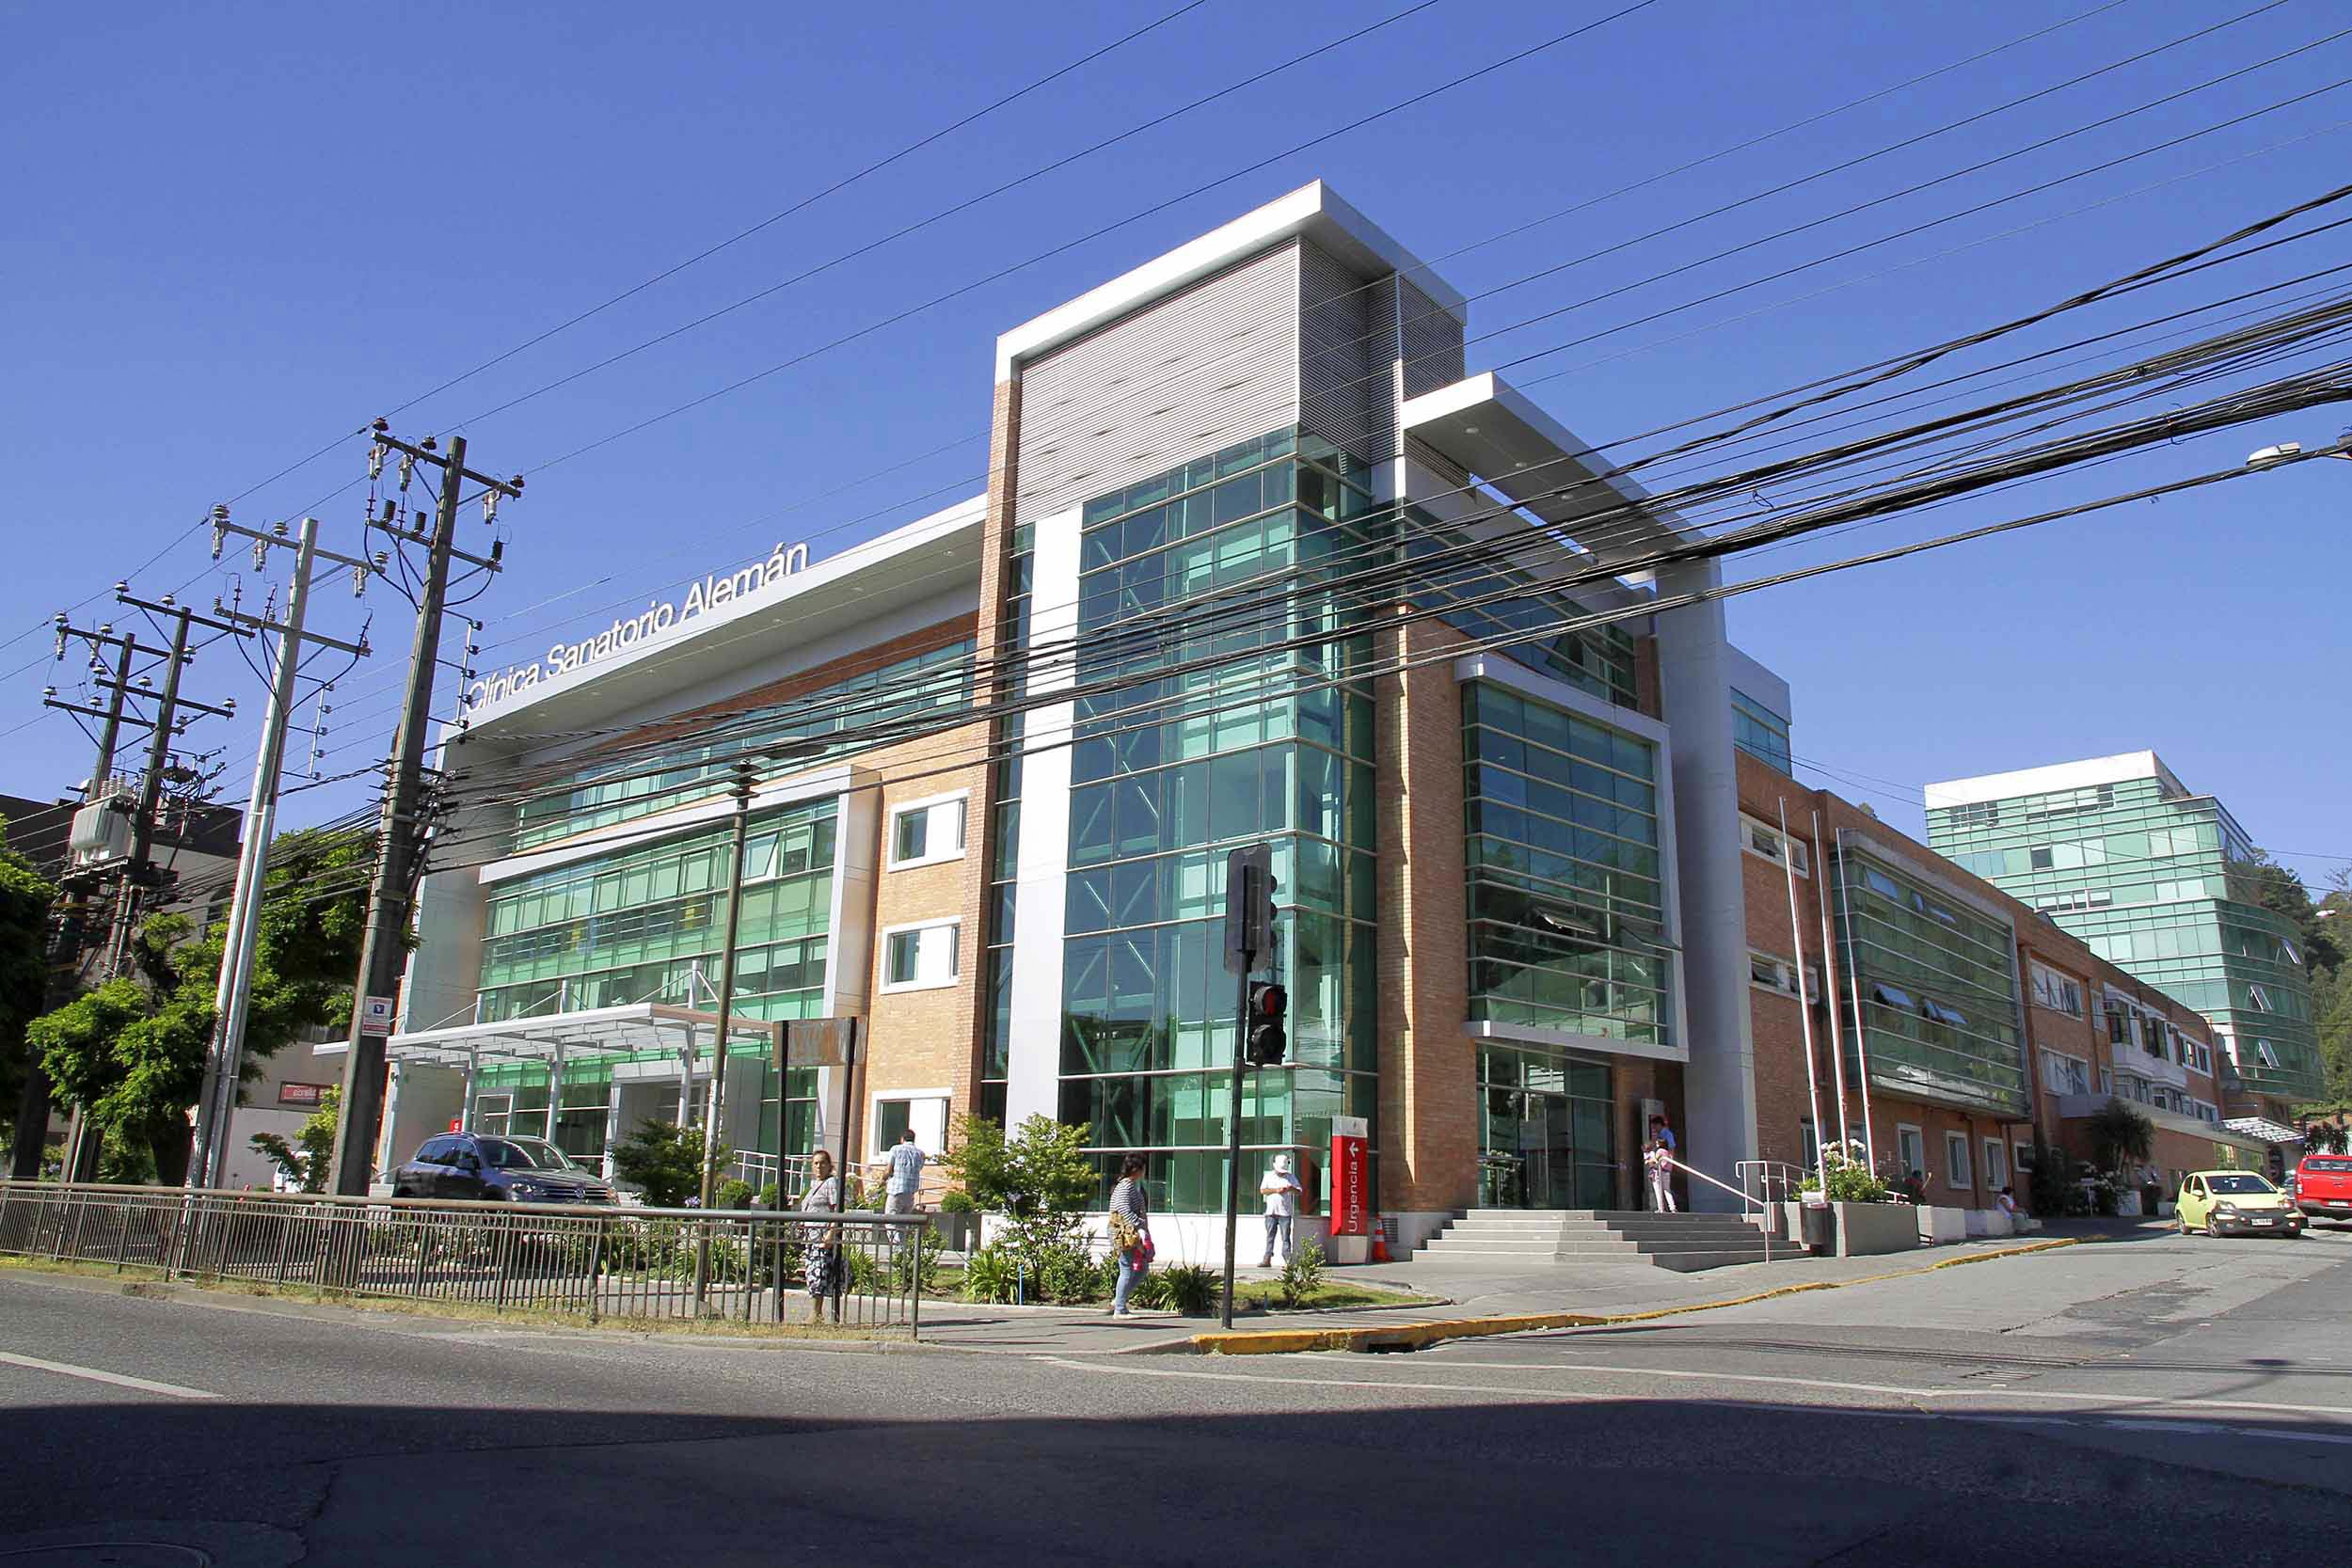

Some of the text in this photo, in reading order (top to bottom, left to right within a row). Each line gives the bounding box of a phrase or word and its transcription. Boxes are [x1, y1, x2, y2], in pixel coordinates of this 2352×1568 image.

[467, 542, 808, 713] Clínica Sanatorio Alemán
[1348, 1161, 1359, 1232] Urgencia
